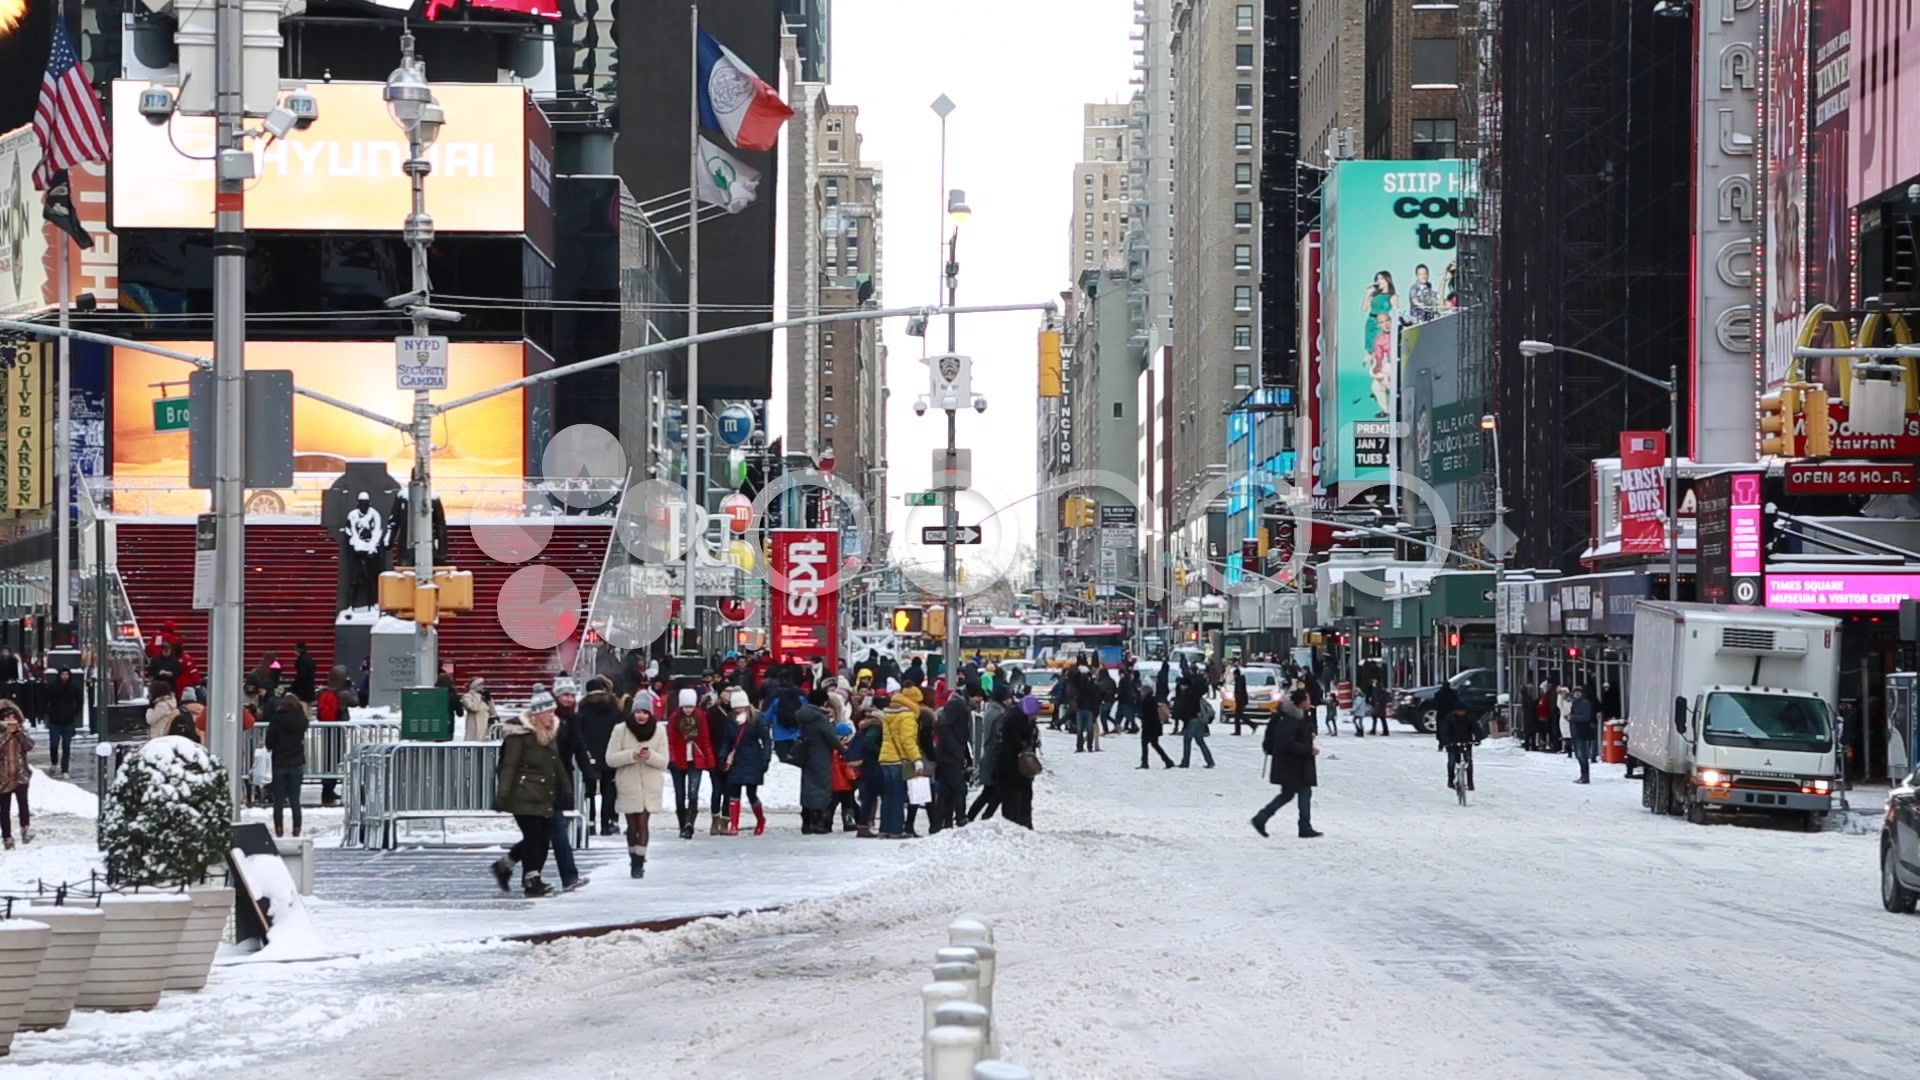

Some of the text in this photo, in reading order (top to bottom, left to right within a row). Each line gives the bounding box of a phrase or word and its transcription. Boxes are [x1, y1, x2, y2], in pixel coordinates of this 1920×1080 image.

[404, 340, 440, 350] NYPD
[398, 364, 445, 375] SECURITY
[400, 375, 443, 386] CAMERA
[1060, 346, 1072, 465] WELLINGTON
[166, 406, 190, 424] Bro
[17, 352, 32, 505] OLIVE GARDEN
[1356, 439, 1386, 449] JAN 7
[1829, 437, 1896, 449] staurant
[1356, 453, 1383, 464] TUES
[1621, 466, 1665, 492] JERSEY
[1838, 471, 1856, 483] 24
[1860, 471, 1911, 483] HOR
[1628, 489, 1662, 513] BOYS
[927, 532, 944, 540] ONE
[642, 571, 736, 589] RENAISANCE
[788, 539, 827, 618] tkts
[1770, 581, 1844, 592] TIMES SQUARE
[1770, 594, 1816, 603] MUSEUM
[1819, 594, 1827, 603] &
[1830, 594, 1868, 603] VISITOR
